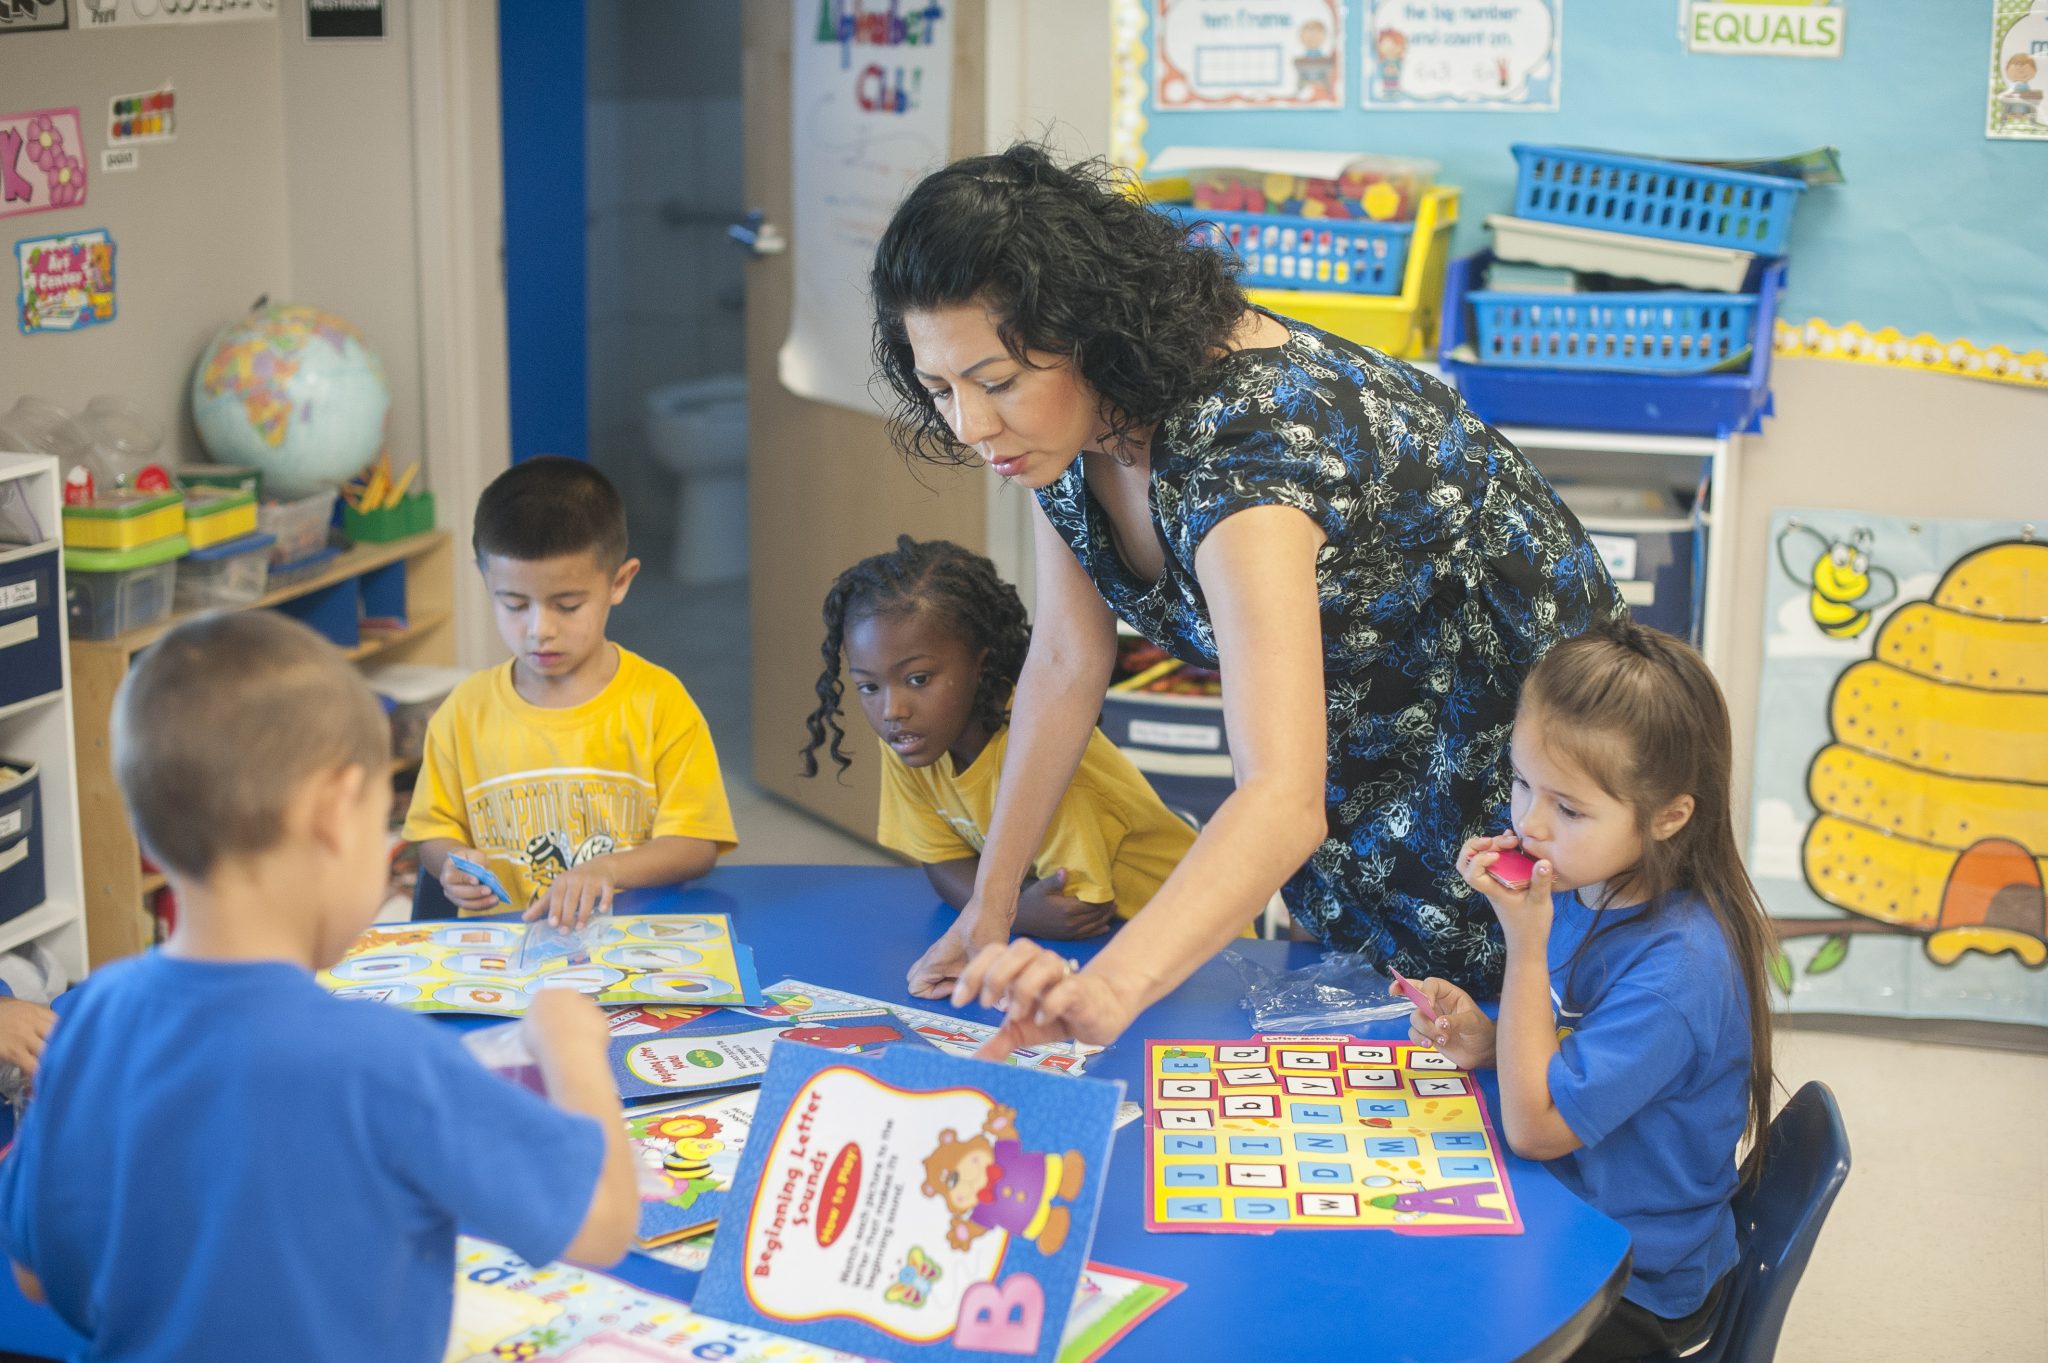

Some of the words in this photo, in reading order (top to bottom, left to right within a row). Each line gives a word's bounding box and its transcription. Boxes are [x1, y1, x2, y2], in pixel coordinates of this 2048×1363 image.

[1694, 11, 1837, 47] EQUALS
[1358, 1050, 1384, 1058] g
[1301, 1082, 1329, 1090] y
[1369, 1104, 1395, 1112] R
[1303, 1110, 1329, 1118] F
[1445, 1136, 1473, 1145] H
[1378, 1142, 1406, 1152] M
[1177, 1171, 1205, 1180] J
[1312, 1169, 1339, 1178] D
[754, 1168, 803, 1277] Beginning
[790, 1091, 822, 1158] Letter
[793, 1151, 828, 1226] Sounds
[866, 1162, 882, 1208] picture
[1181, 1203, 1208, 1213] A
[1248, 1203, 1276, 1213] U
[820, 1207, 840, 1244] How
[832, 1185, 847, 1204] to
[953, 1272, 1045, 1356] B
